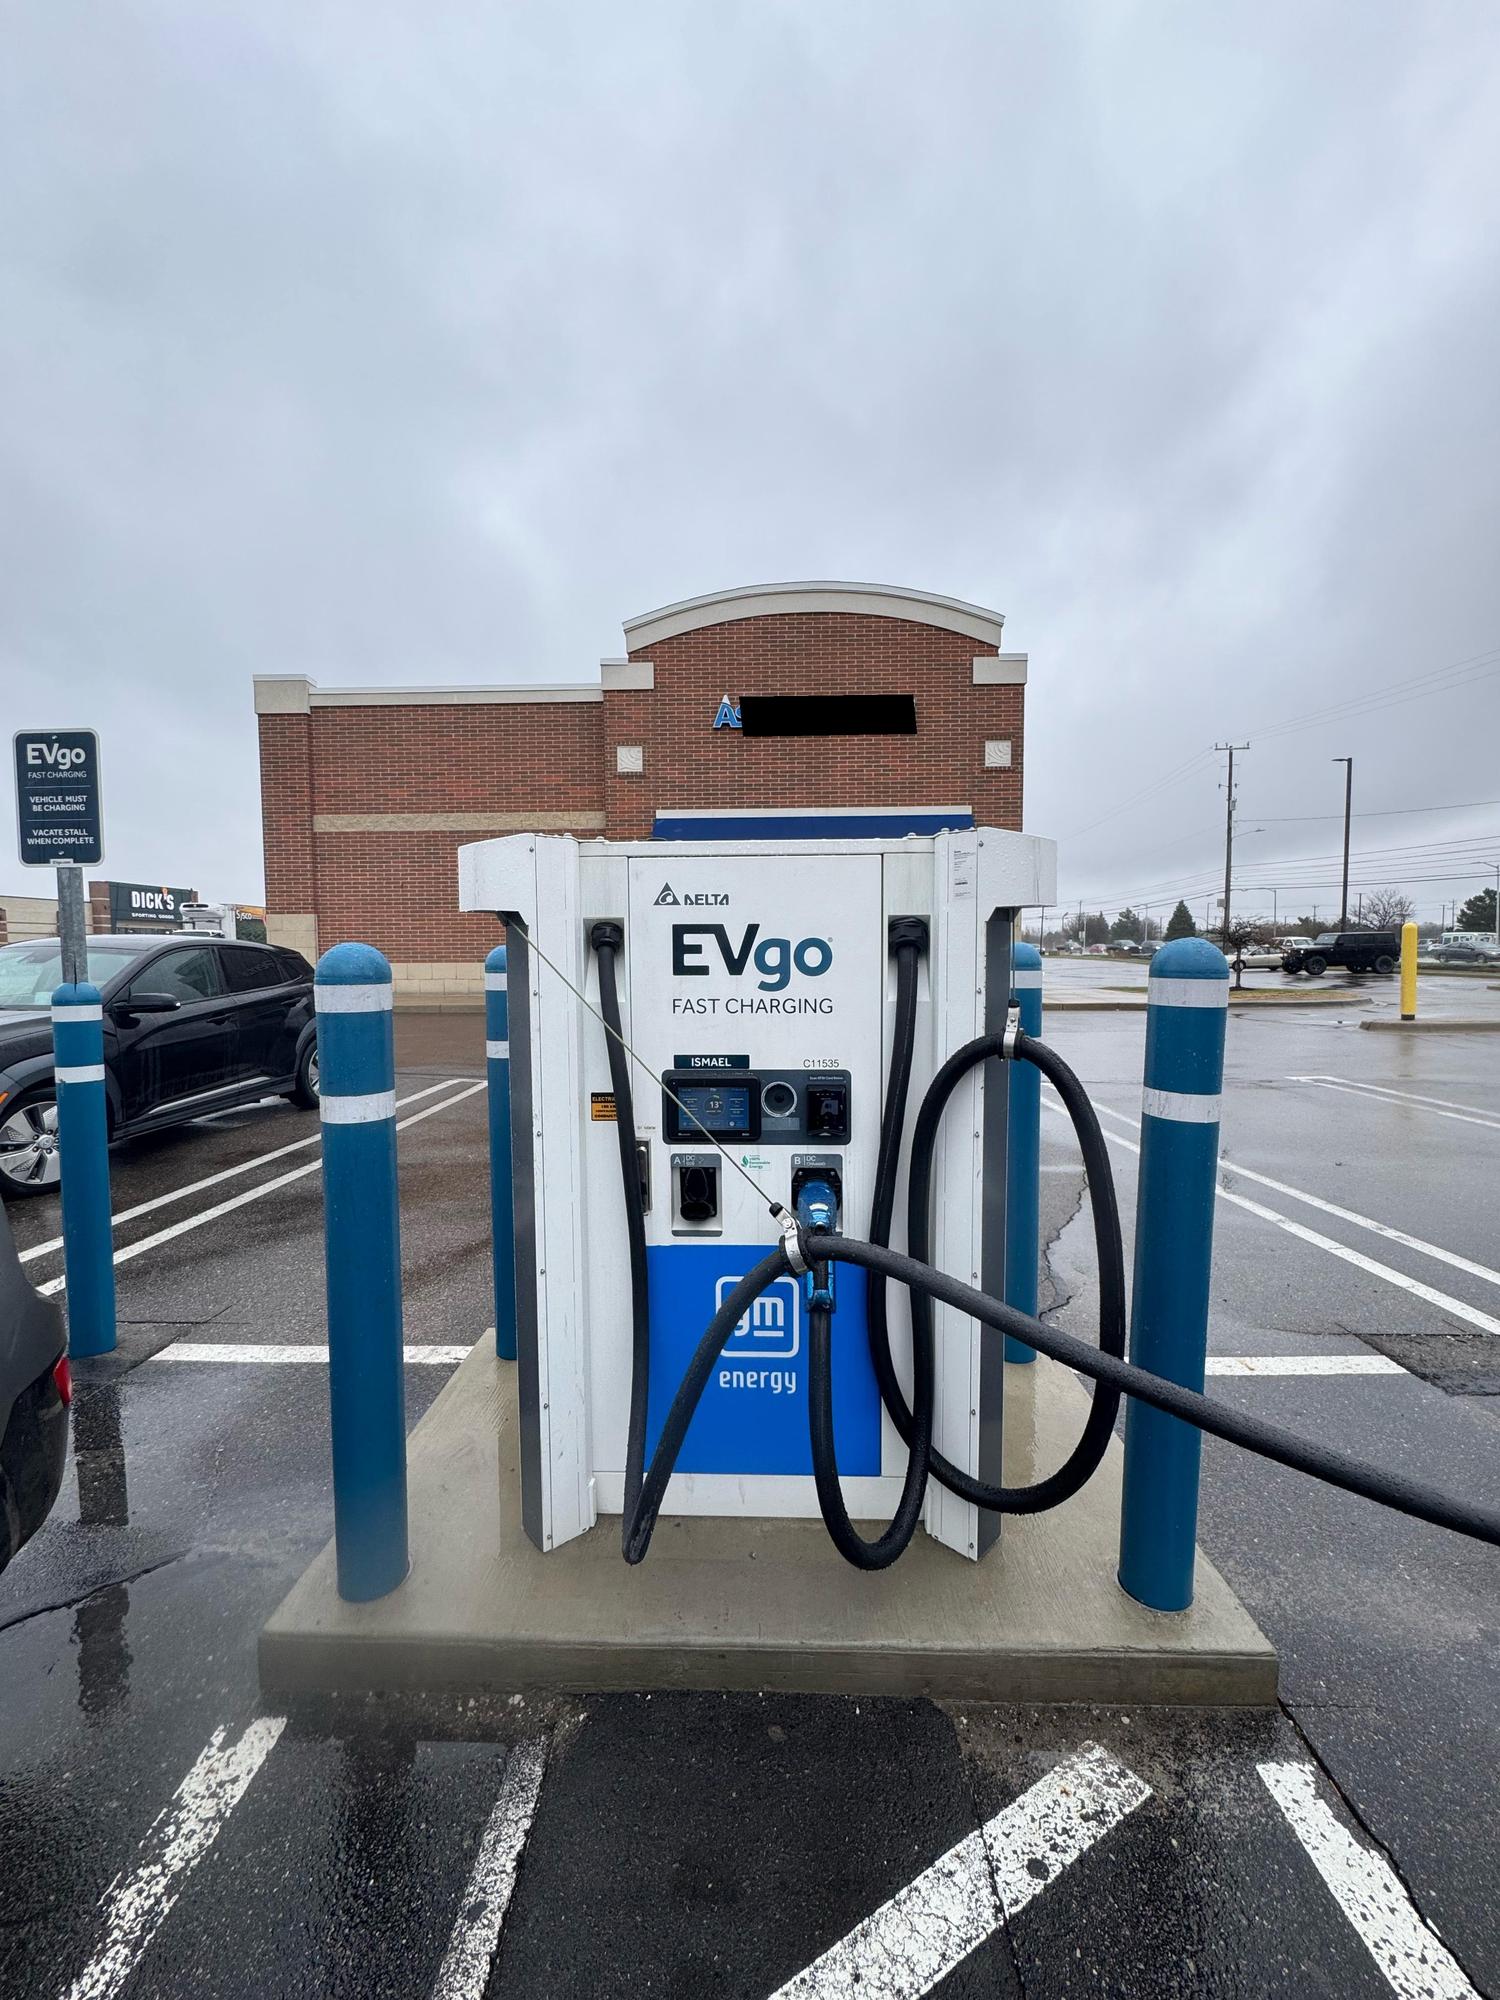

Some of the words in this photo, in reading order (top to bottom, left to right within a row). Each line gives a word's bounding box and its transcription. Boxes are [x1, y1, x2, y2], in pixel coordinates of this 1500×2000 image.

[26, 743, 86, 770] EVgo
[28, 771, 46, 779] FAST
[47, 770, 87, 778] CHARGING
[65, 795, 88, 803] MUST
[32, 804, 43, 812] BE
[44, 804, 86, 812] CHARGING
[64, 828, 88, 836] STALL
[27, 837, 51, 845] WHEN
[52, 837, 94, 845] COMPLETE
[131, 890, 174, 910] DICK'S
[684, 893, 729, 906] DELTA
[672, 923, 833, 992] EVgo
[672, 998, 721, 1014] FAST
[725, 998, 833, 1014] CHARGING
[691, 1057, 732, 1067] ISMAEL
[803, 1058, 840, 1068] C11535
[673, 1156, 681, 1165] A
[794, 1156, 801, 1165] B
[719, 1370, 797, 1394] energy
